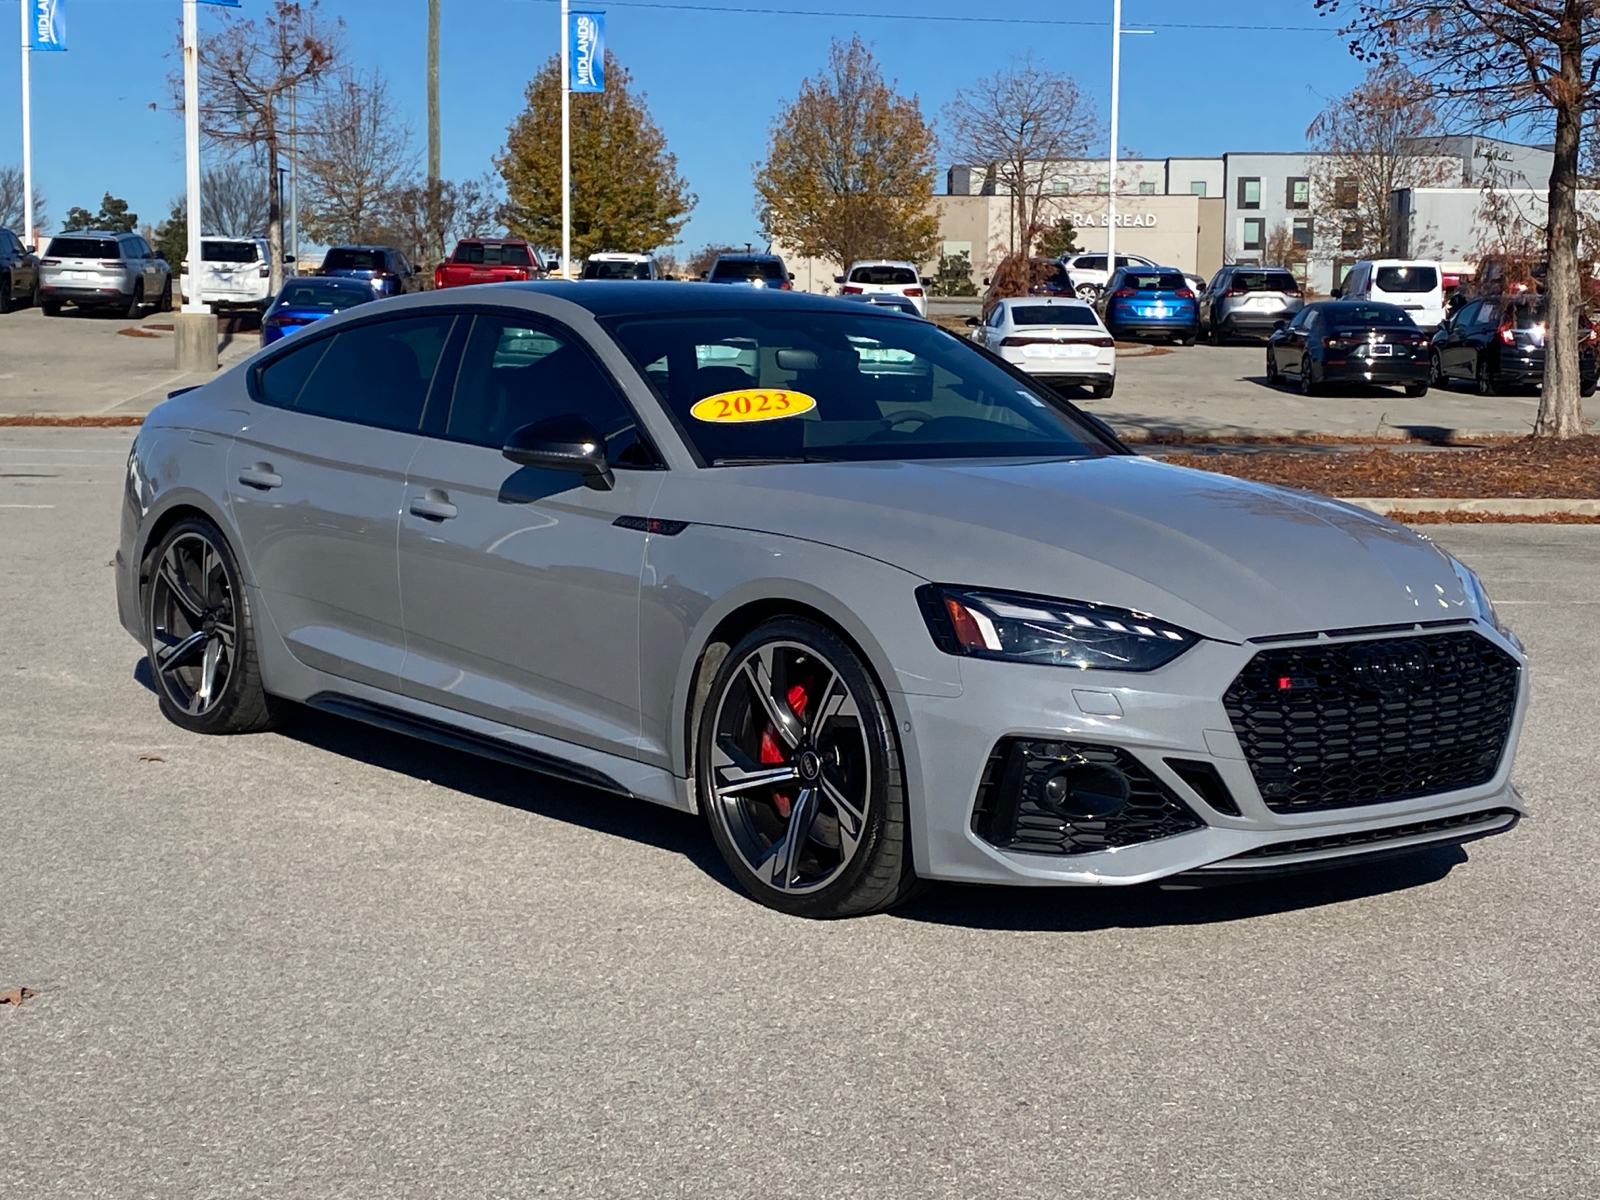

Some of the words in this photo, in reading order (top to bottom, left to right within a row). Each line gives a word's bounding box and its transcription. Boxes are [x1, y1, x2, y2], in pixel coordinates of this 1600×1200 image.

[577, 16, 589, 85] MIDLANDS
[1101, 213, 1157, 228] BREAD
[714, 393, 790, 418] 2023
